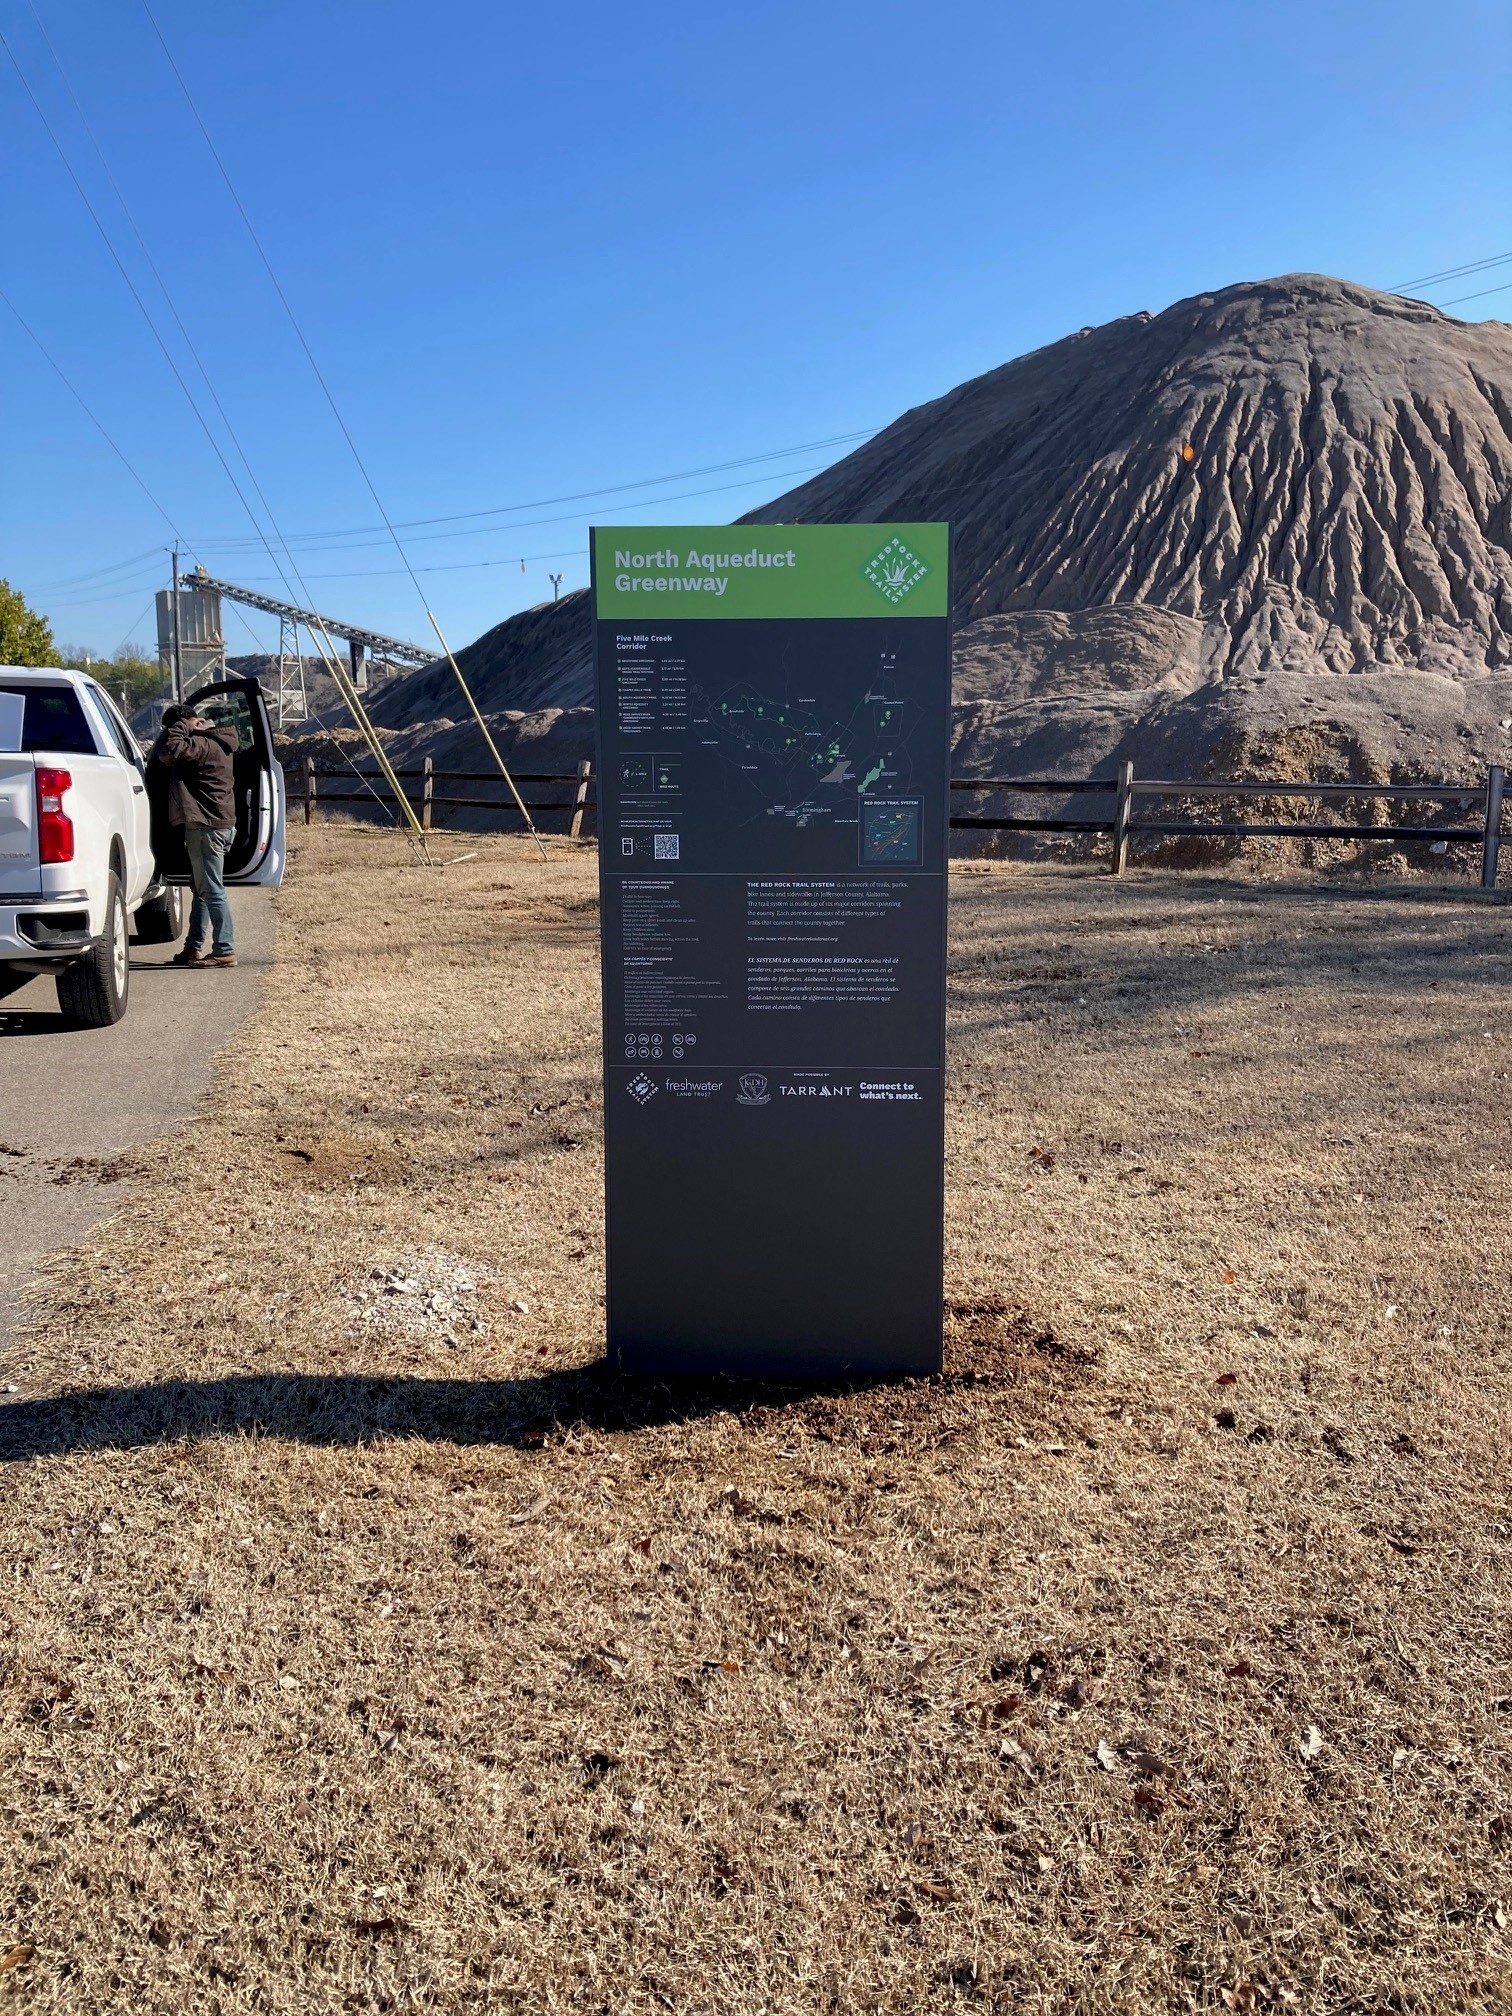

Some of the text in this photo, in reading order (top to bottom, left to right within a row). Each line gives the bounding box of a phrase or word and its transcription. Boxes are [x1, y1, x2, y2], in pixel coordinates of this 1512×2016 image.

[615, 549, 796, 573] North Aqueduct
[892, 538, 920, 568] ROCK
[615, 574, 728, 596] Greenway
[864, 566, 928, 603] TRAIL SYSTEM
[666, 1079, 722, 1090] freshwater
[780, 1086, 852, 1097] TARRANT
[860, 1082, 901, 1090] Connect
